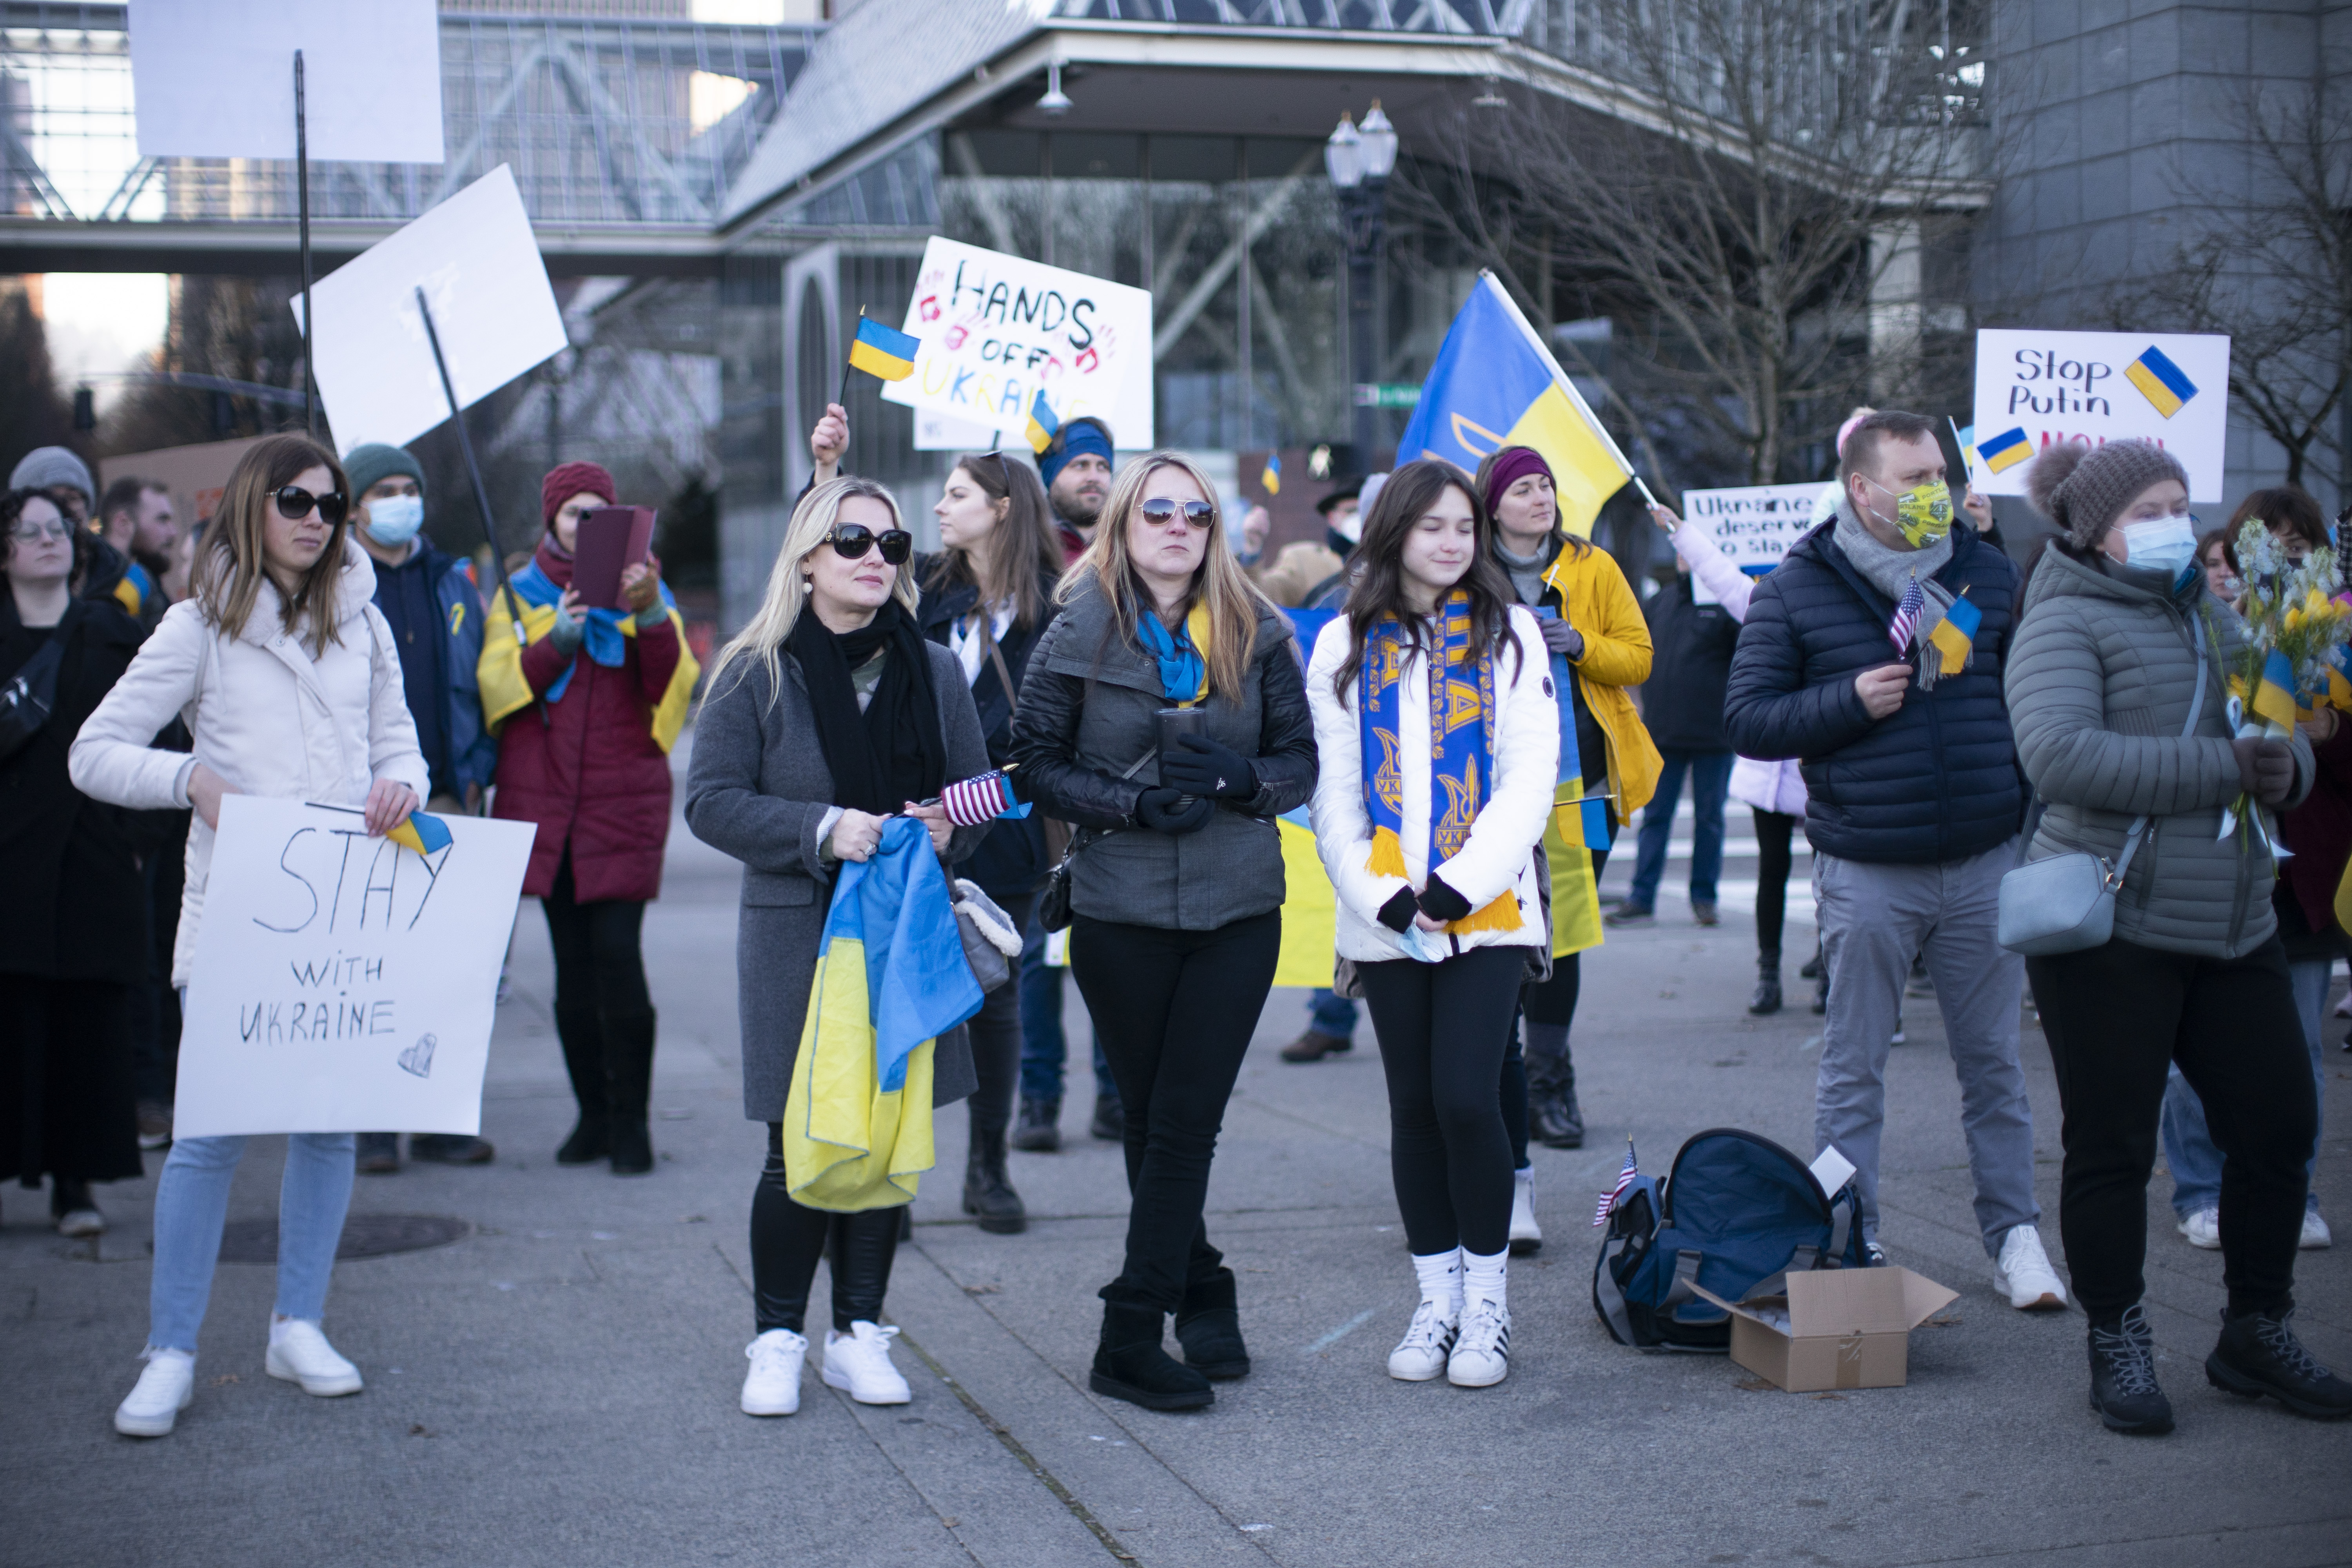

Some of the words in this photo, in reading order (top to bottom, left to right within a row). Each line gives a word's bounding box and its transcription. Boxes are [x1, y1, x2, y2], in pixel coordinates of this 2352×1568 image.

[951, 259, 1096, 350] HANDS
[982, 338, 1052, 368] OFF
[2014, 349, 2112, 393] Stop
[2008, 385, 2111, 416] Putin
[1694, 491, 1811, 515] Ukraine
[253, 827, 454, 934] STAY
